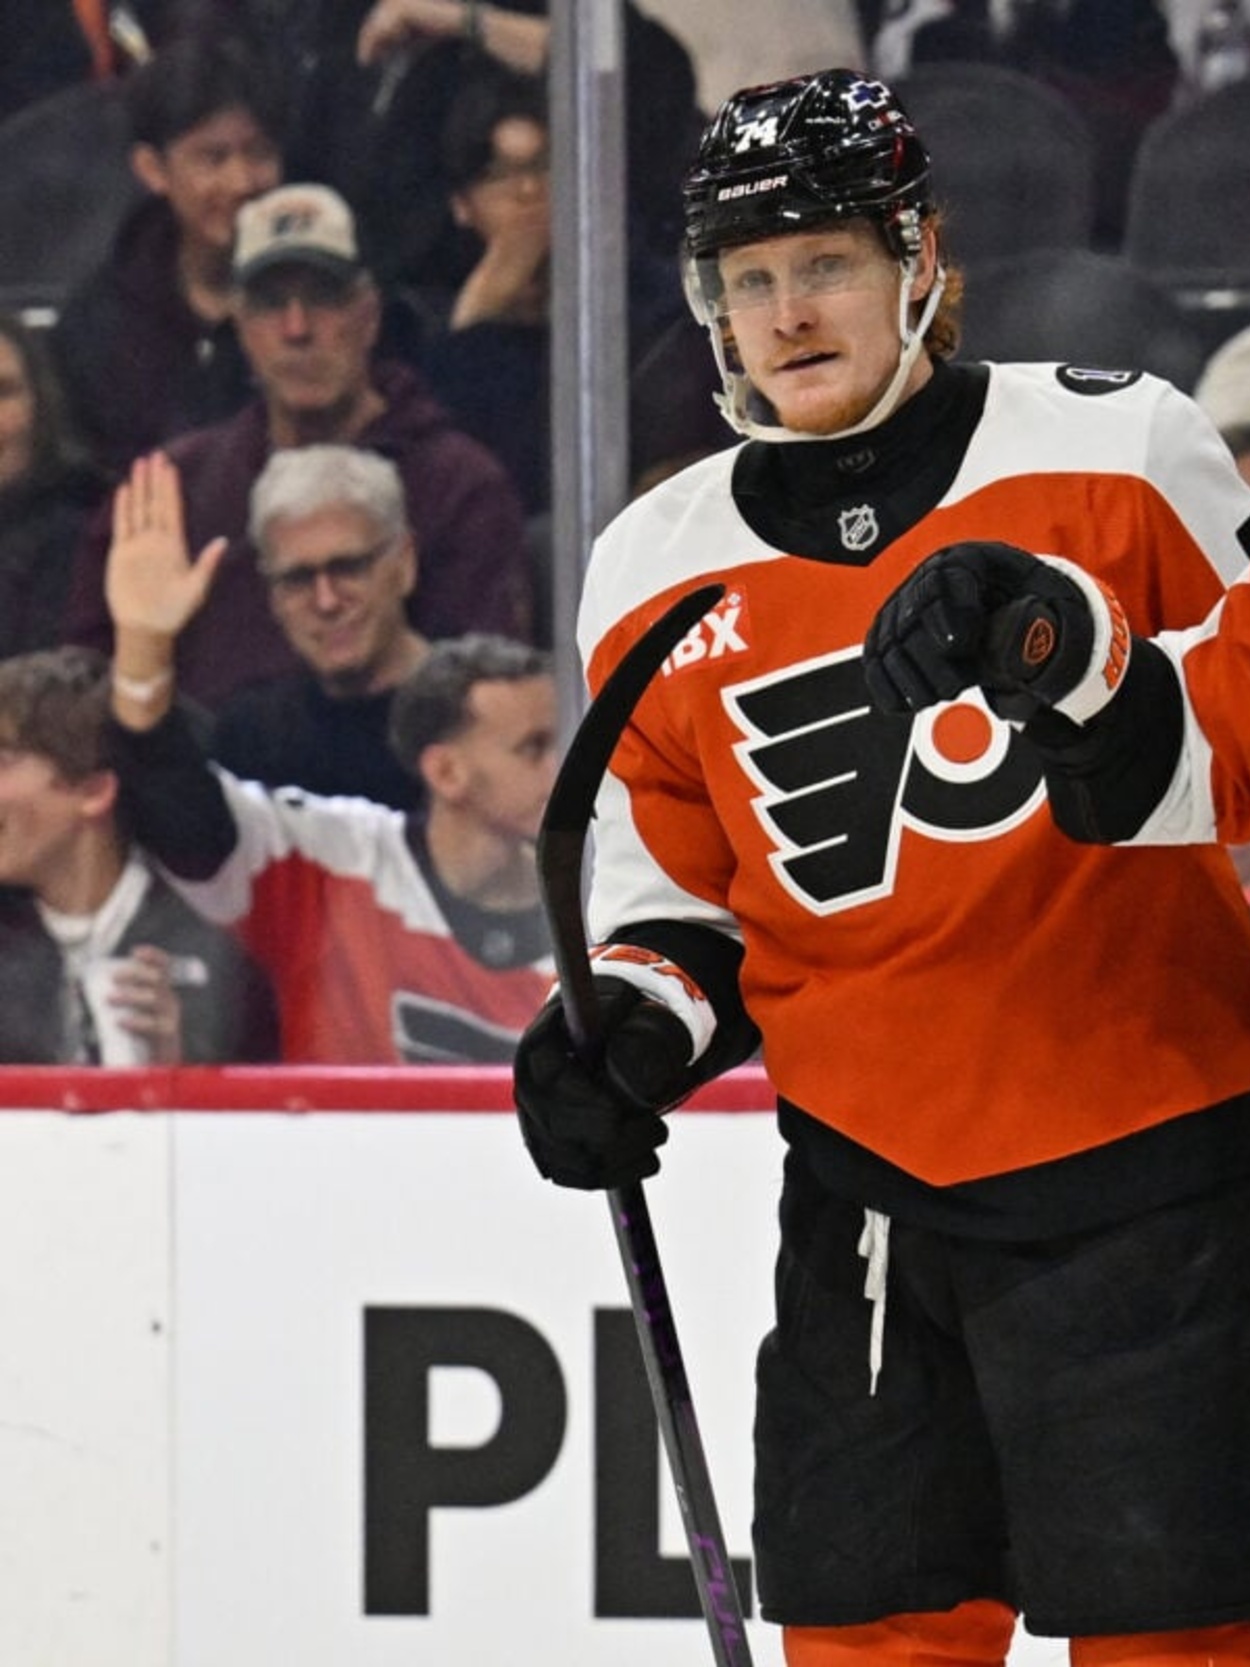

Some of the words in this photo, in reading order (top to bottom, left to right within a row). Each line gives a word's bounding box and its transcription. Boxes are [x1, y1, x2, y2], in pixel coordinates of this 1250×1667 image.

[734, 116, 779, 153] 74
[717, 175, 789, 201] BAUER
[363, 1304, 753, 1619] PL
